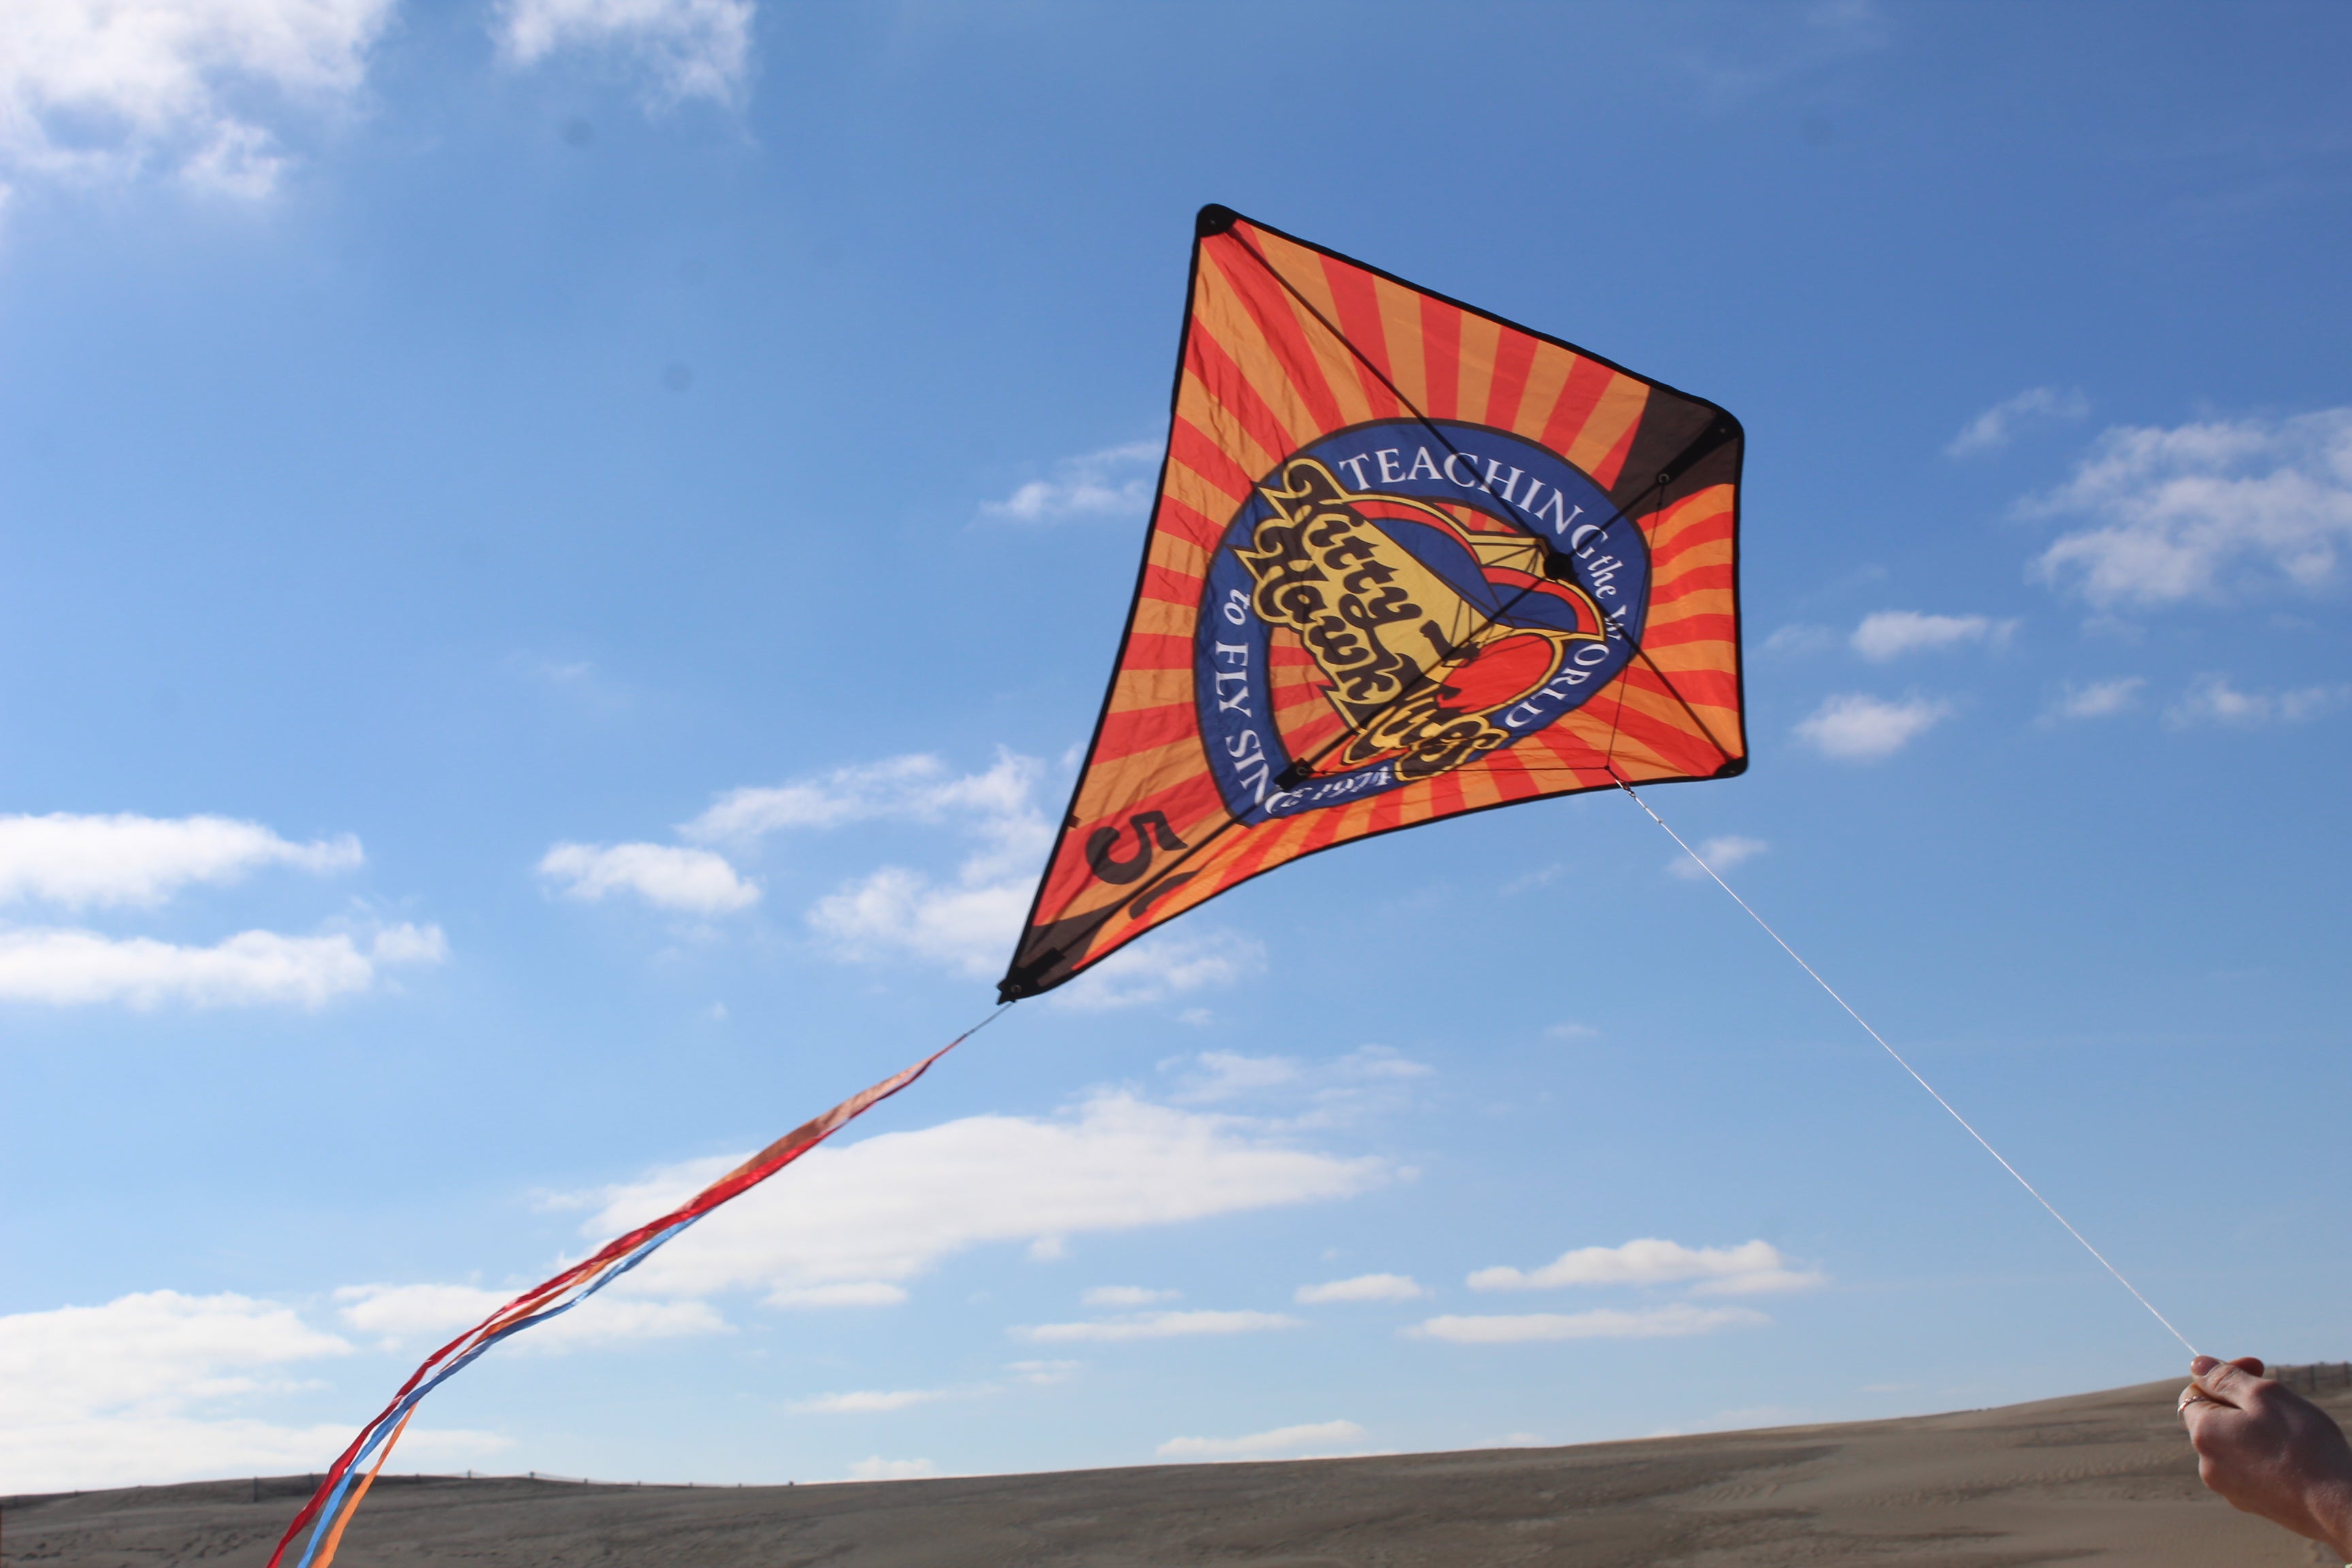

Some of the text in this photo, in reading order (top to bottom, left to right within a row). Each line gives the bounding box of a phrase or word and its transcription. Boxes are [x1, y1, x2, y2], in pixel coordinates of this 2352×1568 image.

[1258, 457, 1424, 630] Kitty
[1338, 446, 1609, 559] TEACHING
[1223, 589, 1252, 625] to
[1240, 520, 1406, 704] Hawk
[1586, 555, 1624, 600] the
[1215, 640, 1252, 718] FLY
[1504, 604, 1627, 728] WORLD
[1309, 766, 1392, 801] 1974
